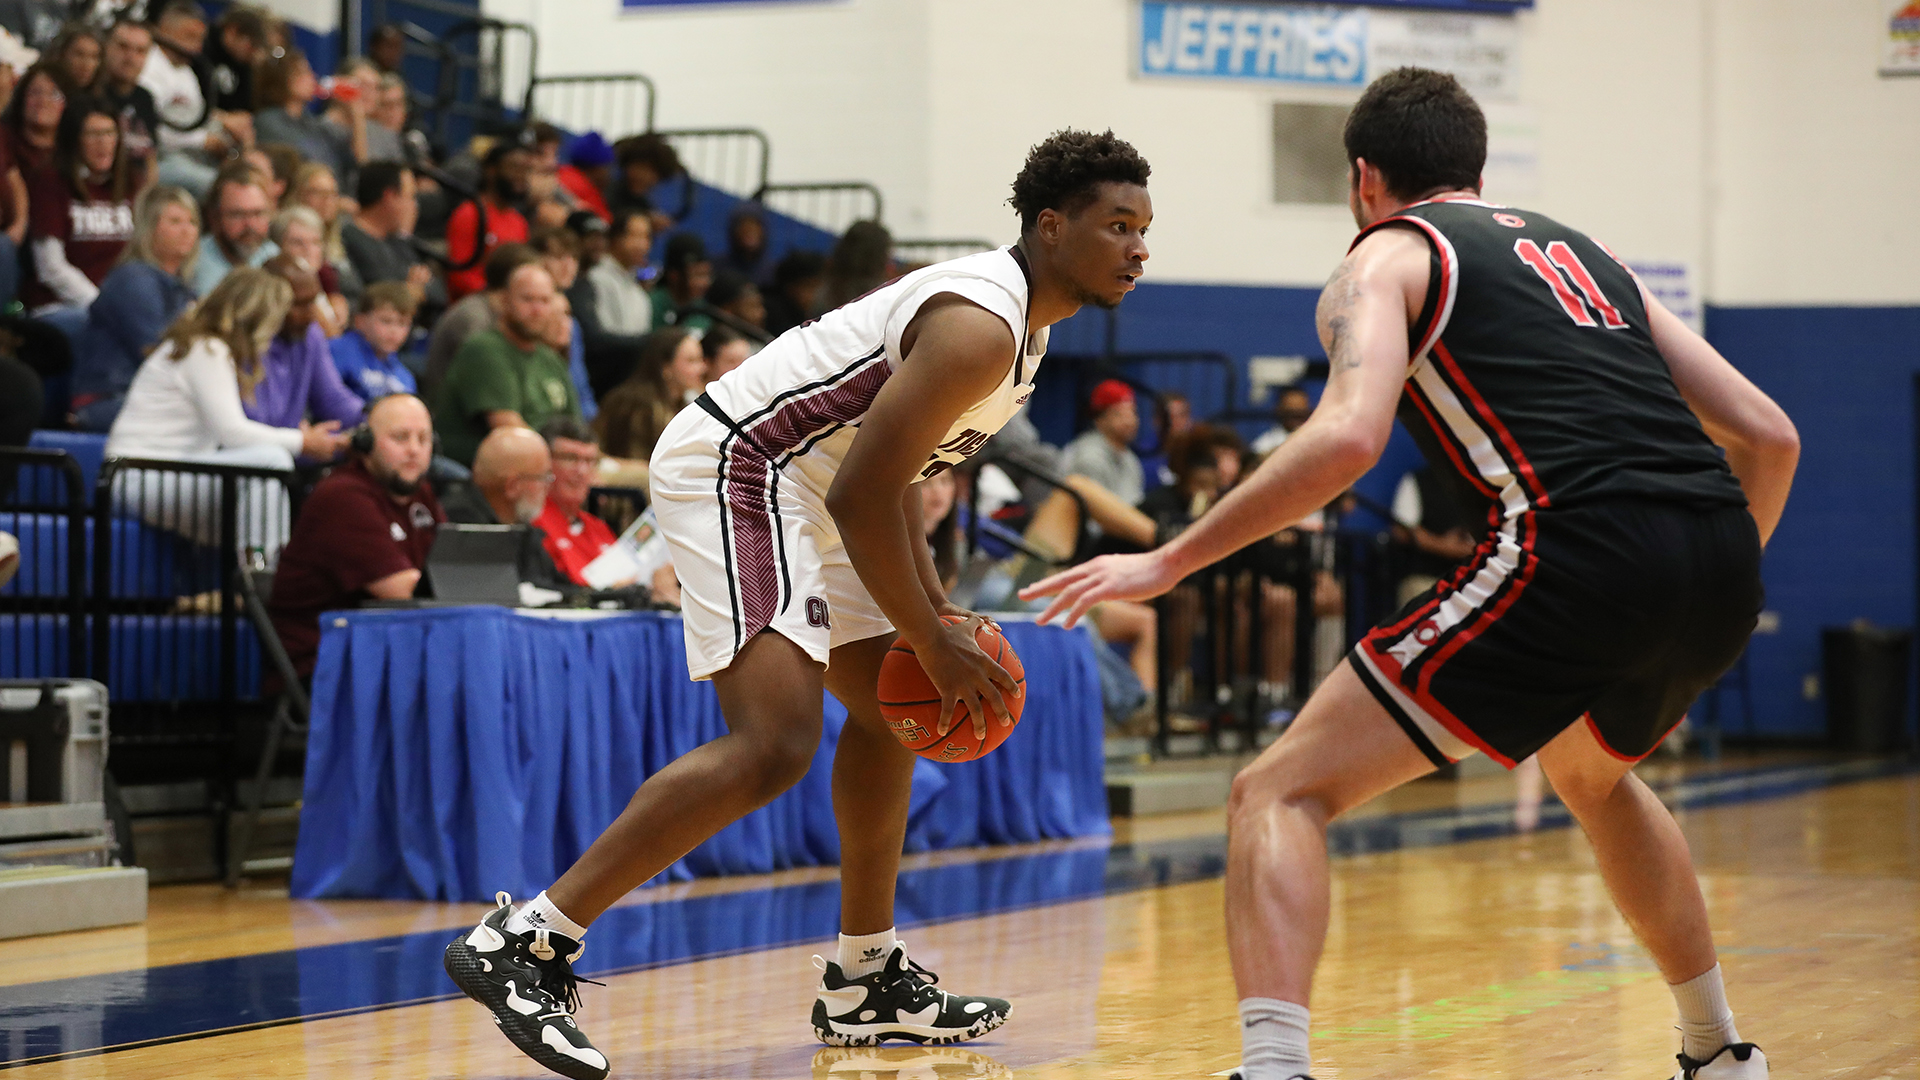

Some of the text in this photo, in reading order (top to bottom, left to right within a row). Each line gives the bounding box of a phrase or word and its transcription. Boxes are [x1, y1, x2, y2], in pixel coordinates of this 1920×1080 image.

[1147, 6, 1366, 79] JEFFRIES
[1513, 238, 1630, 329] 11
[523, 915, 542, 930] adida
